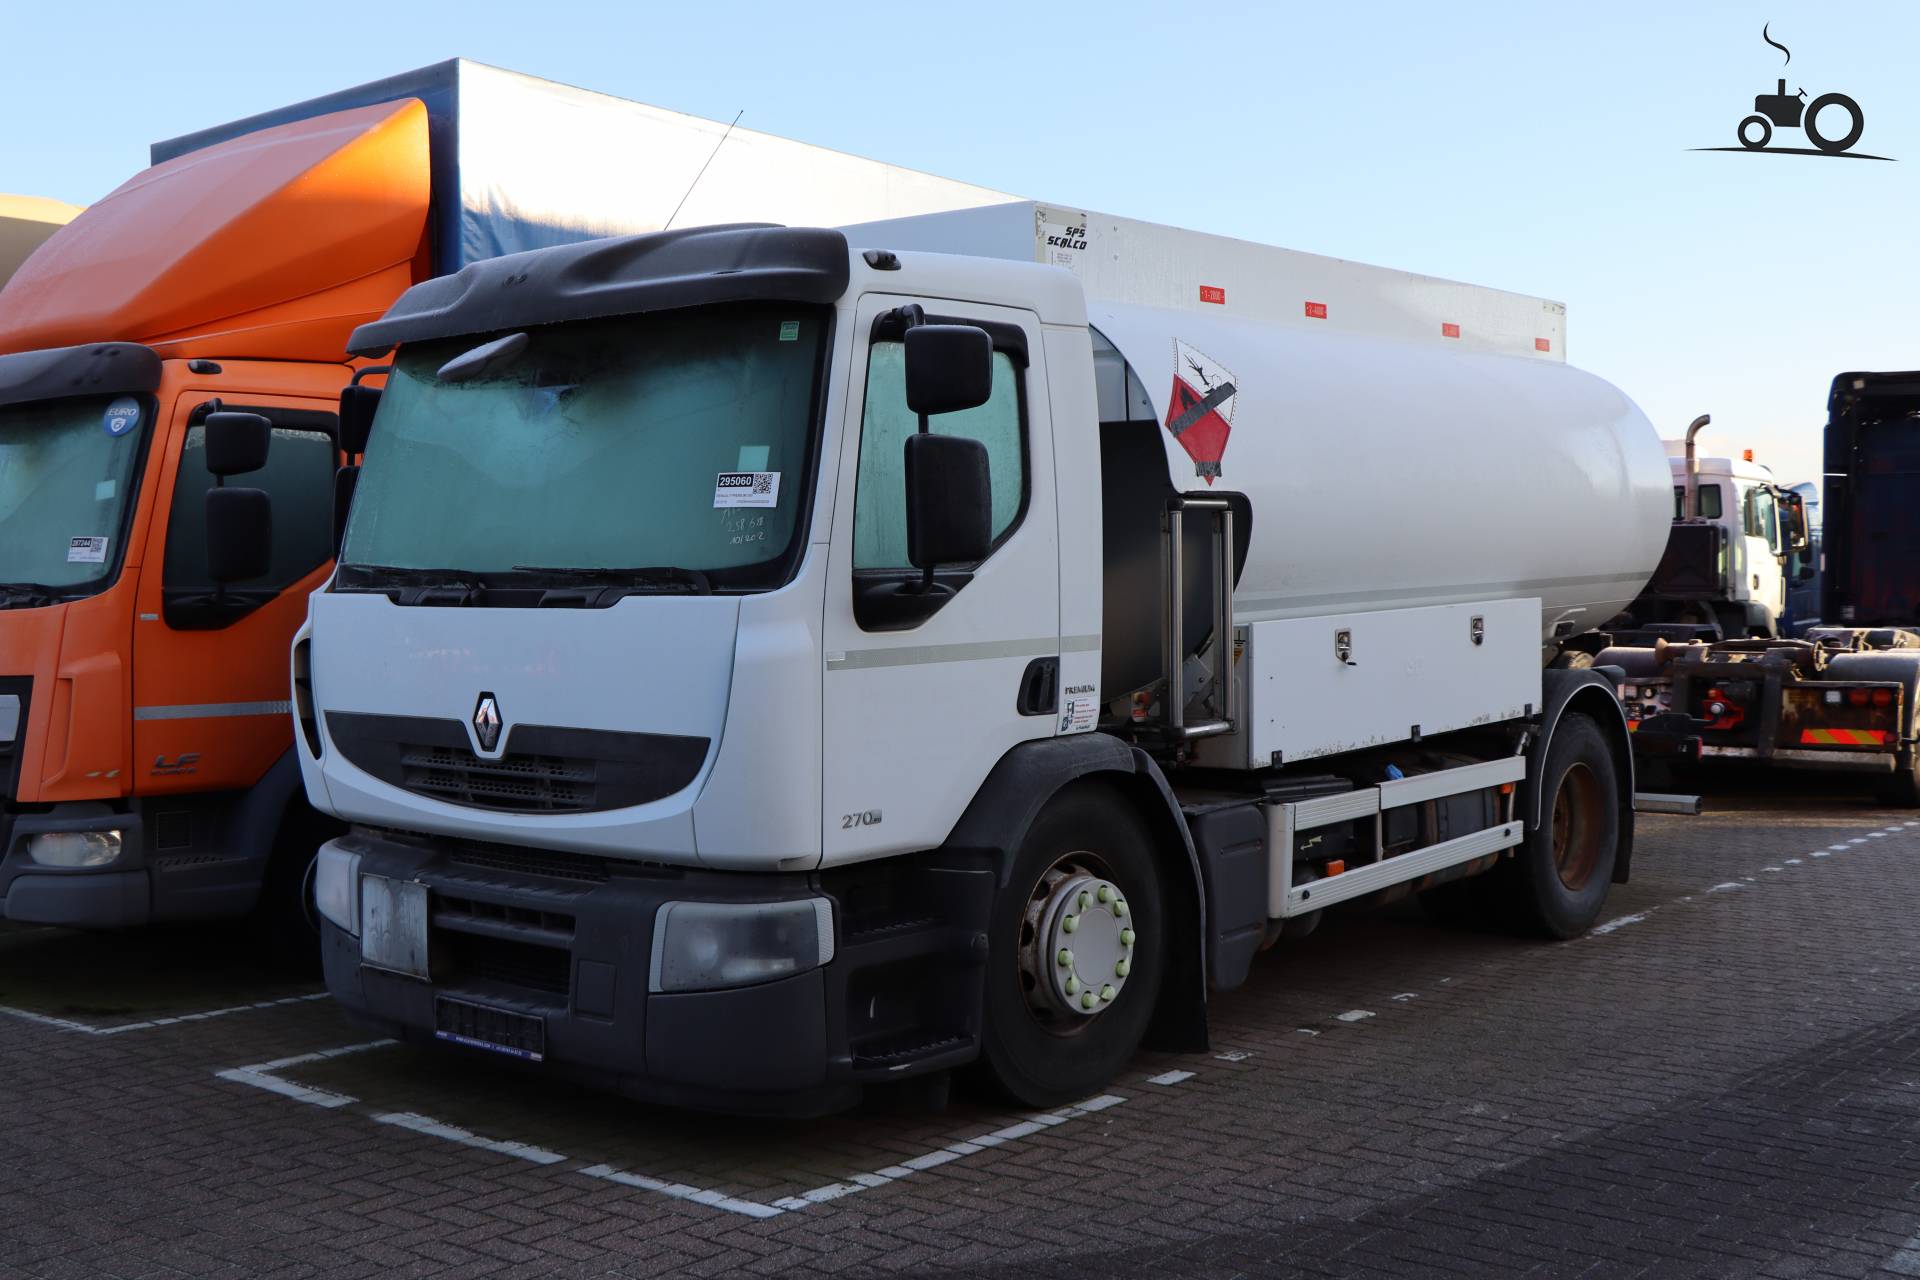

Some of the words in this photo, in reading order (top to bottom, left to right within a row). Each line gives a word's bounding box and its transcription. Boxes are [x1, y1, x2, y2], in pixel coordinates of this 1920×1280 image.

[1065, 226, 1086, 238] SPS
[1047, 236, 1087, 250] SCALCO
[108, 408, 137, 416] EURO
[719, 476, 752, 486] 295060
[1064, 685, 1096, 695] PREMIUM
[154, 753, 201, 768] LF
[842, 811, 872, 829] 270
